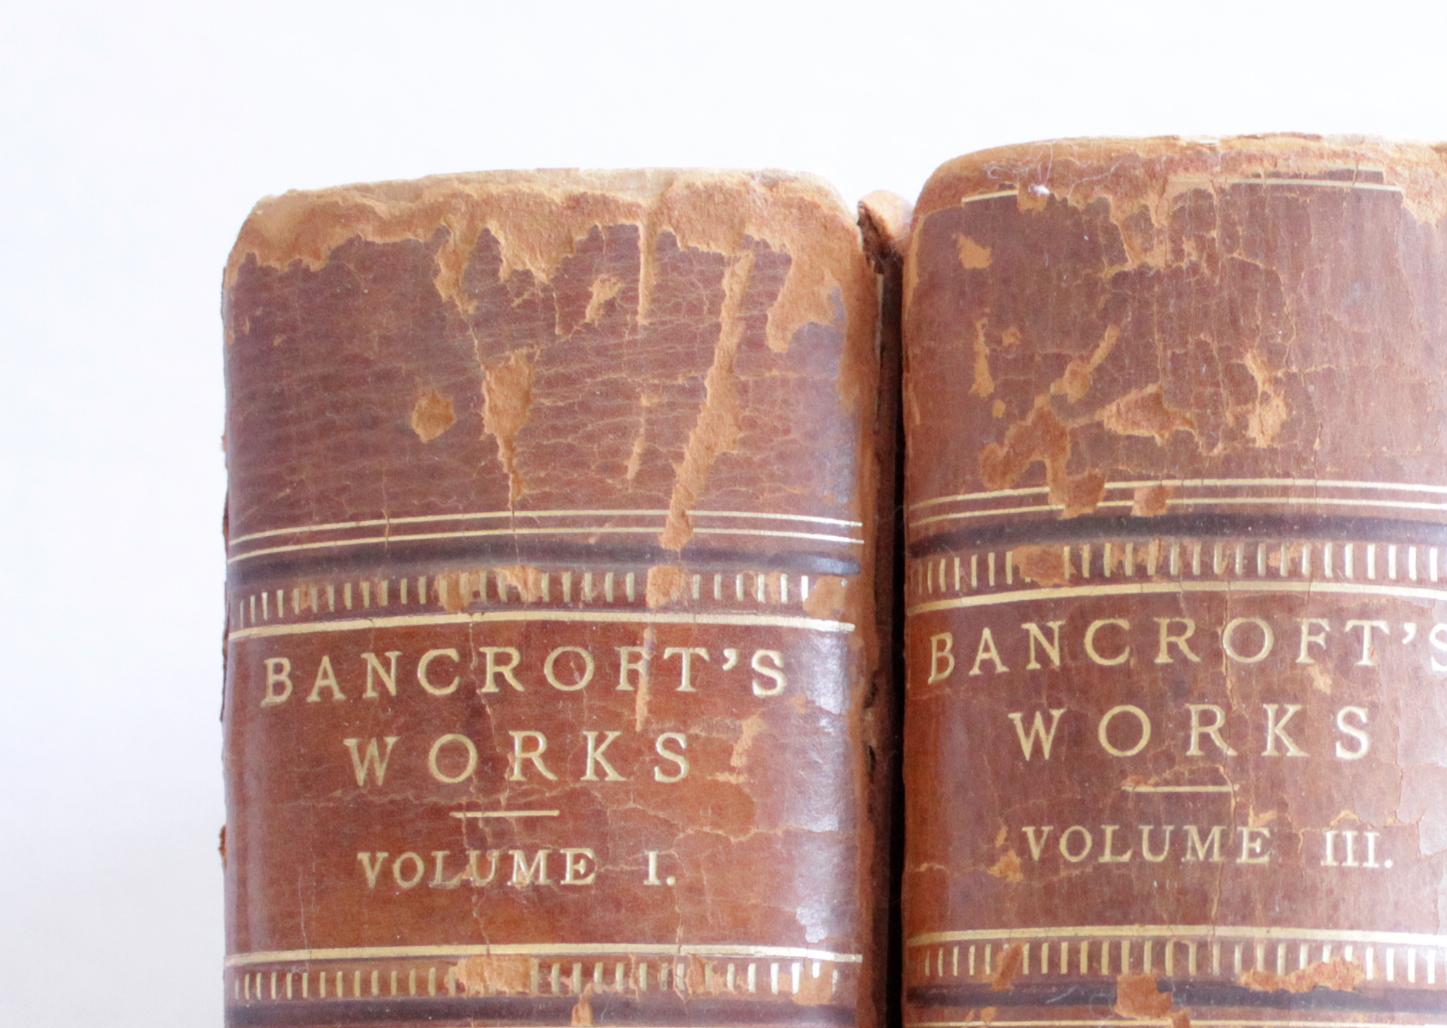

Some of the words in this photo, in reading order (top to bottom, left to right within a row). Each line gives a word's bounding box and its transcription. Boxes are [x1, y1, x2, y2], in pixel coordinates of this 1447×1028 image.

[260, 645, 790, 707] BANCROFT'S
[343, 730, 691, 786] WORKS
[1008, 704, 1371, 761] WORKS
[358, 847, 596, 890] VOLUME
[643, 850, 677, 886] I.
[1021, 824, 1273, 865] VOLUME
[1320, 829, 1394, 869] III.
